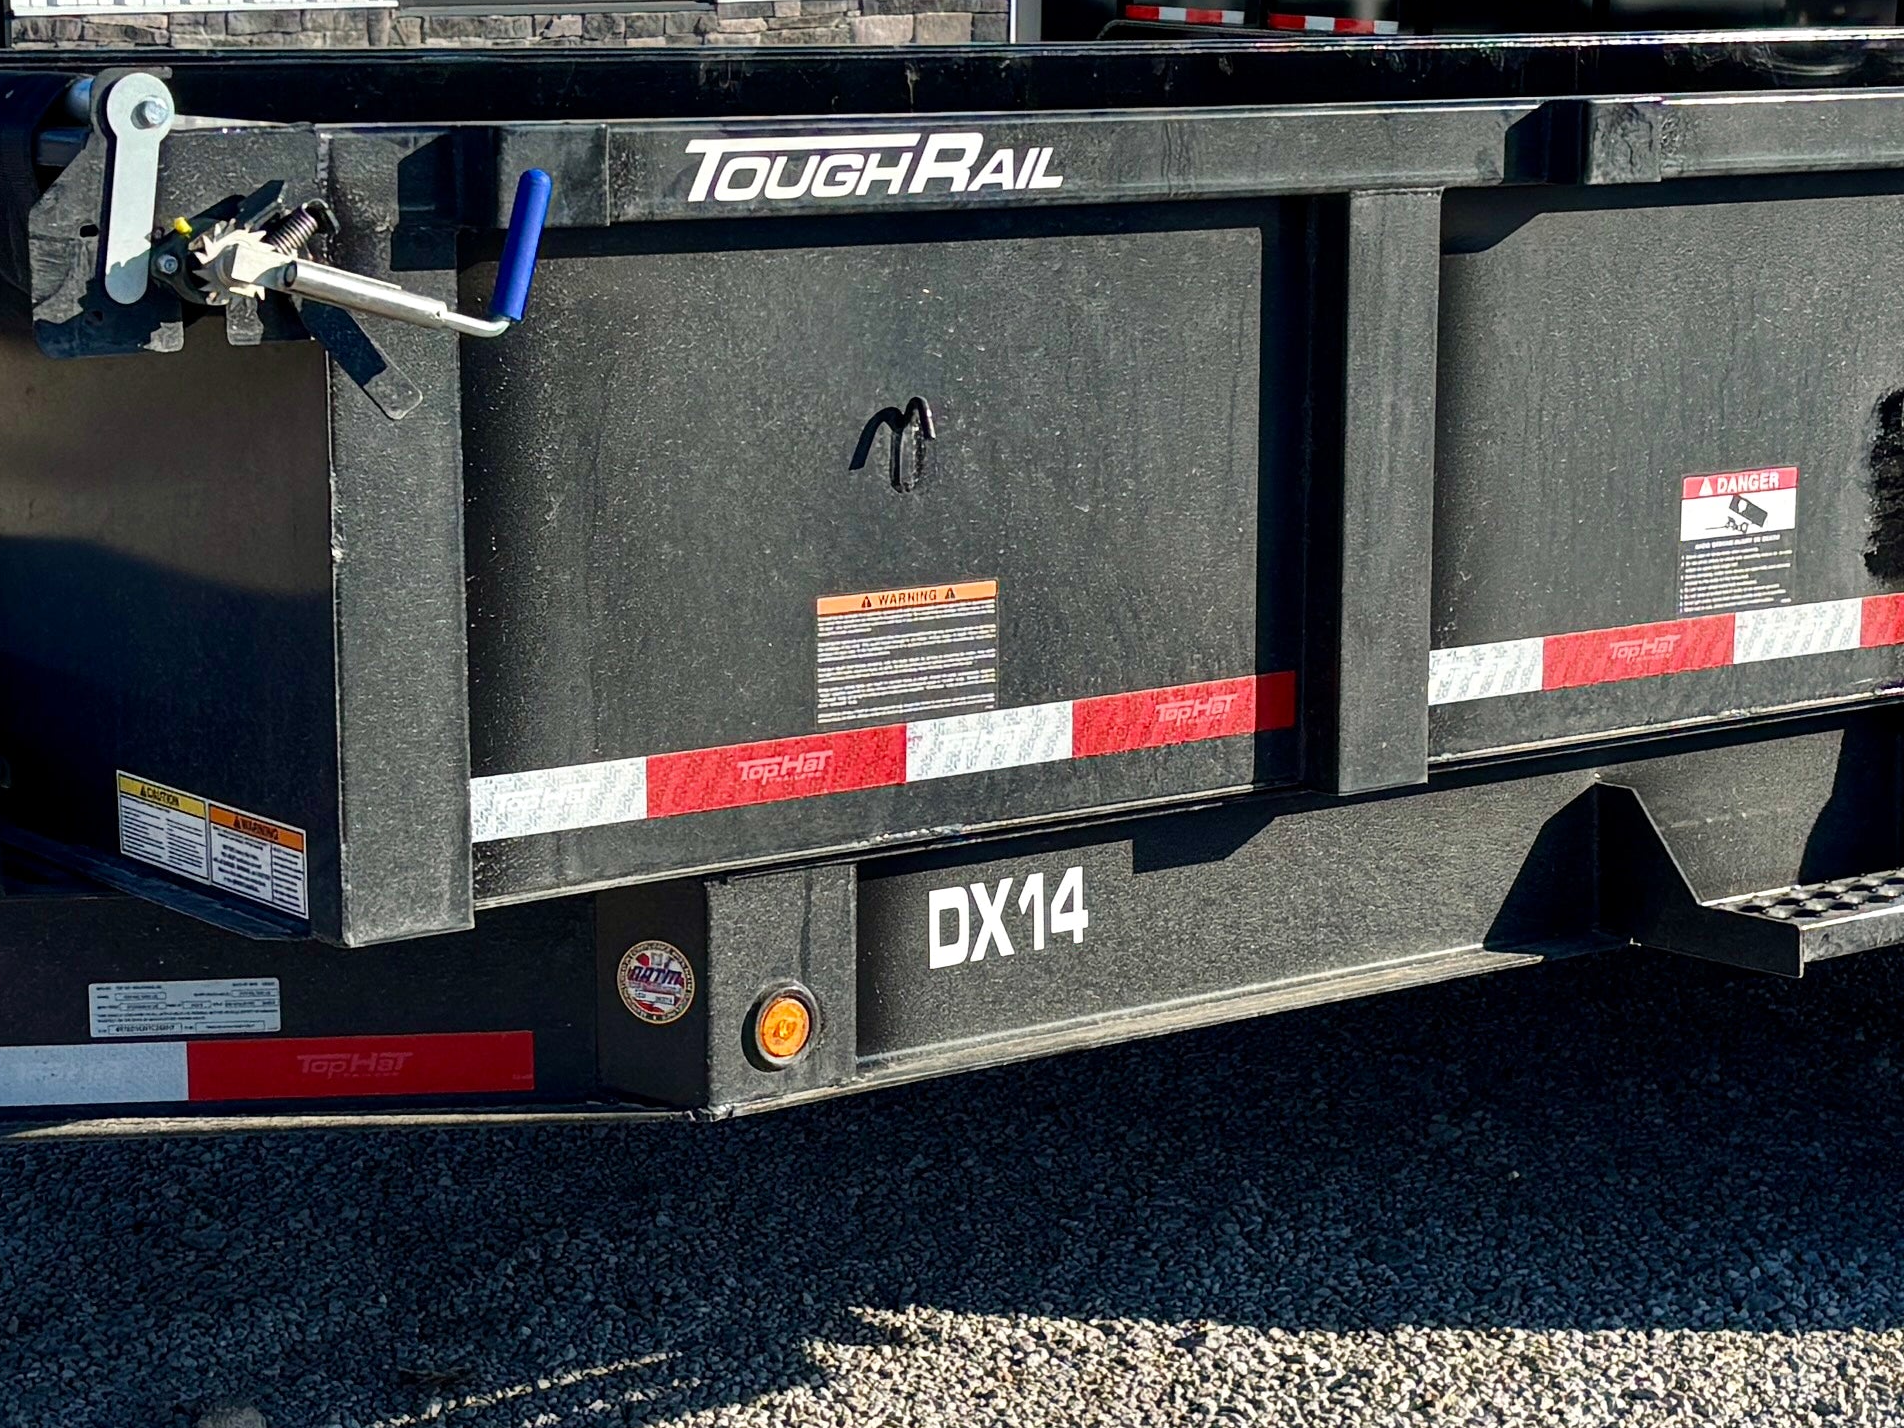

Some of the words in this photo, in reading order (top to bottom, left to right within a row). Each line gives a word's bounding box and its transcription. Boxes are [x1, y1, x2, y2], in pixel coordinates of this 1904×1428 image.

[1717, 472, 1780, 495] DANGER
[878, 588, 937, 607] WARNING
[146, 784, 180, 808] CAUTION
[240, 817, 279, 841] WARNING
[929, 866, 1089, 970] DX14
